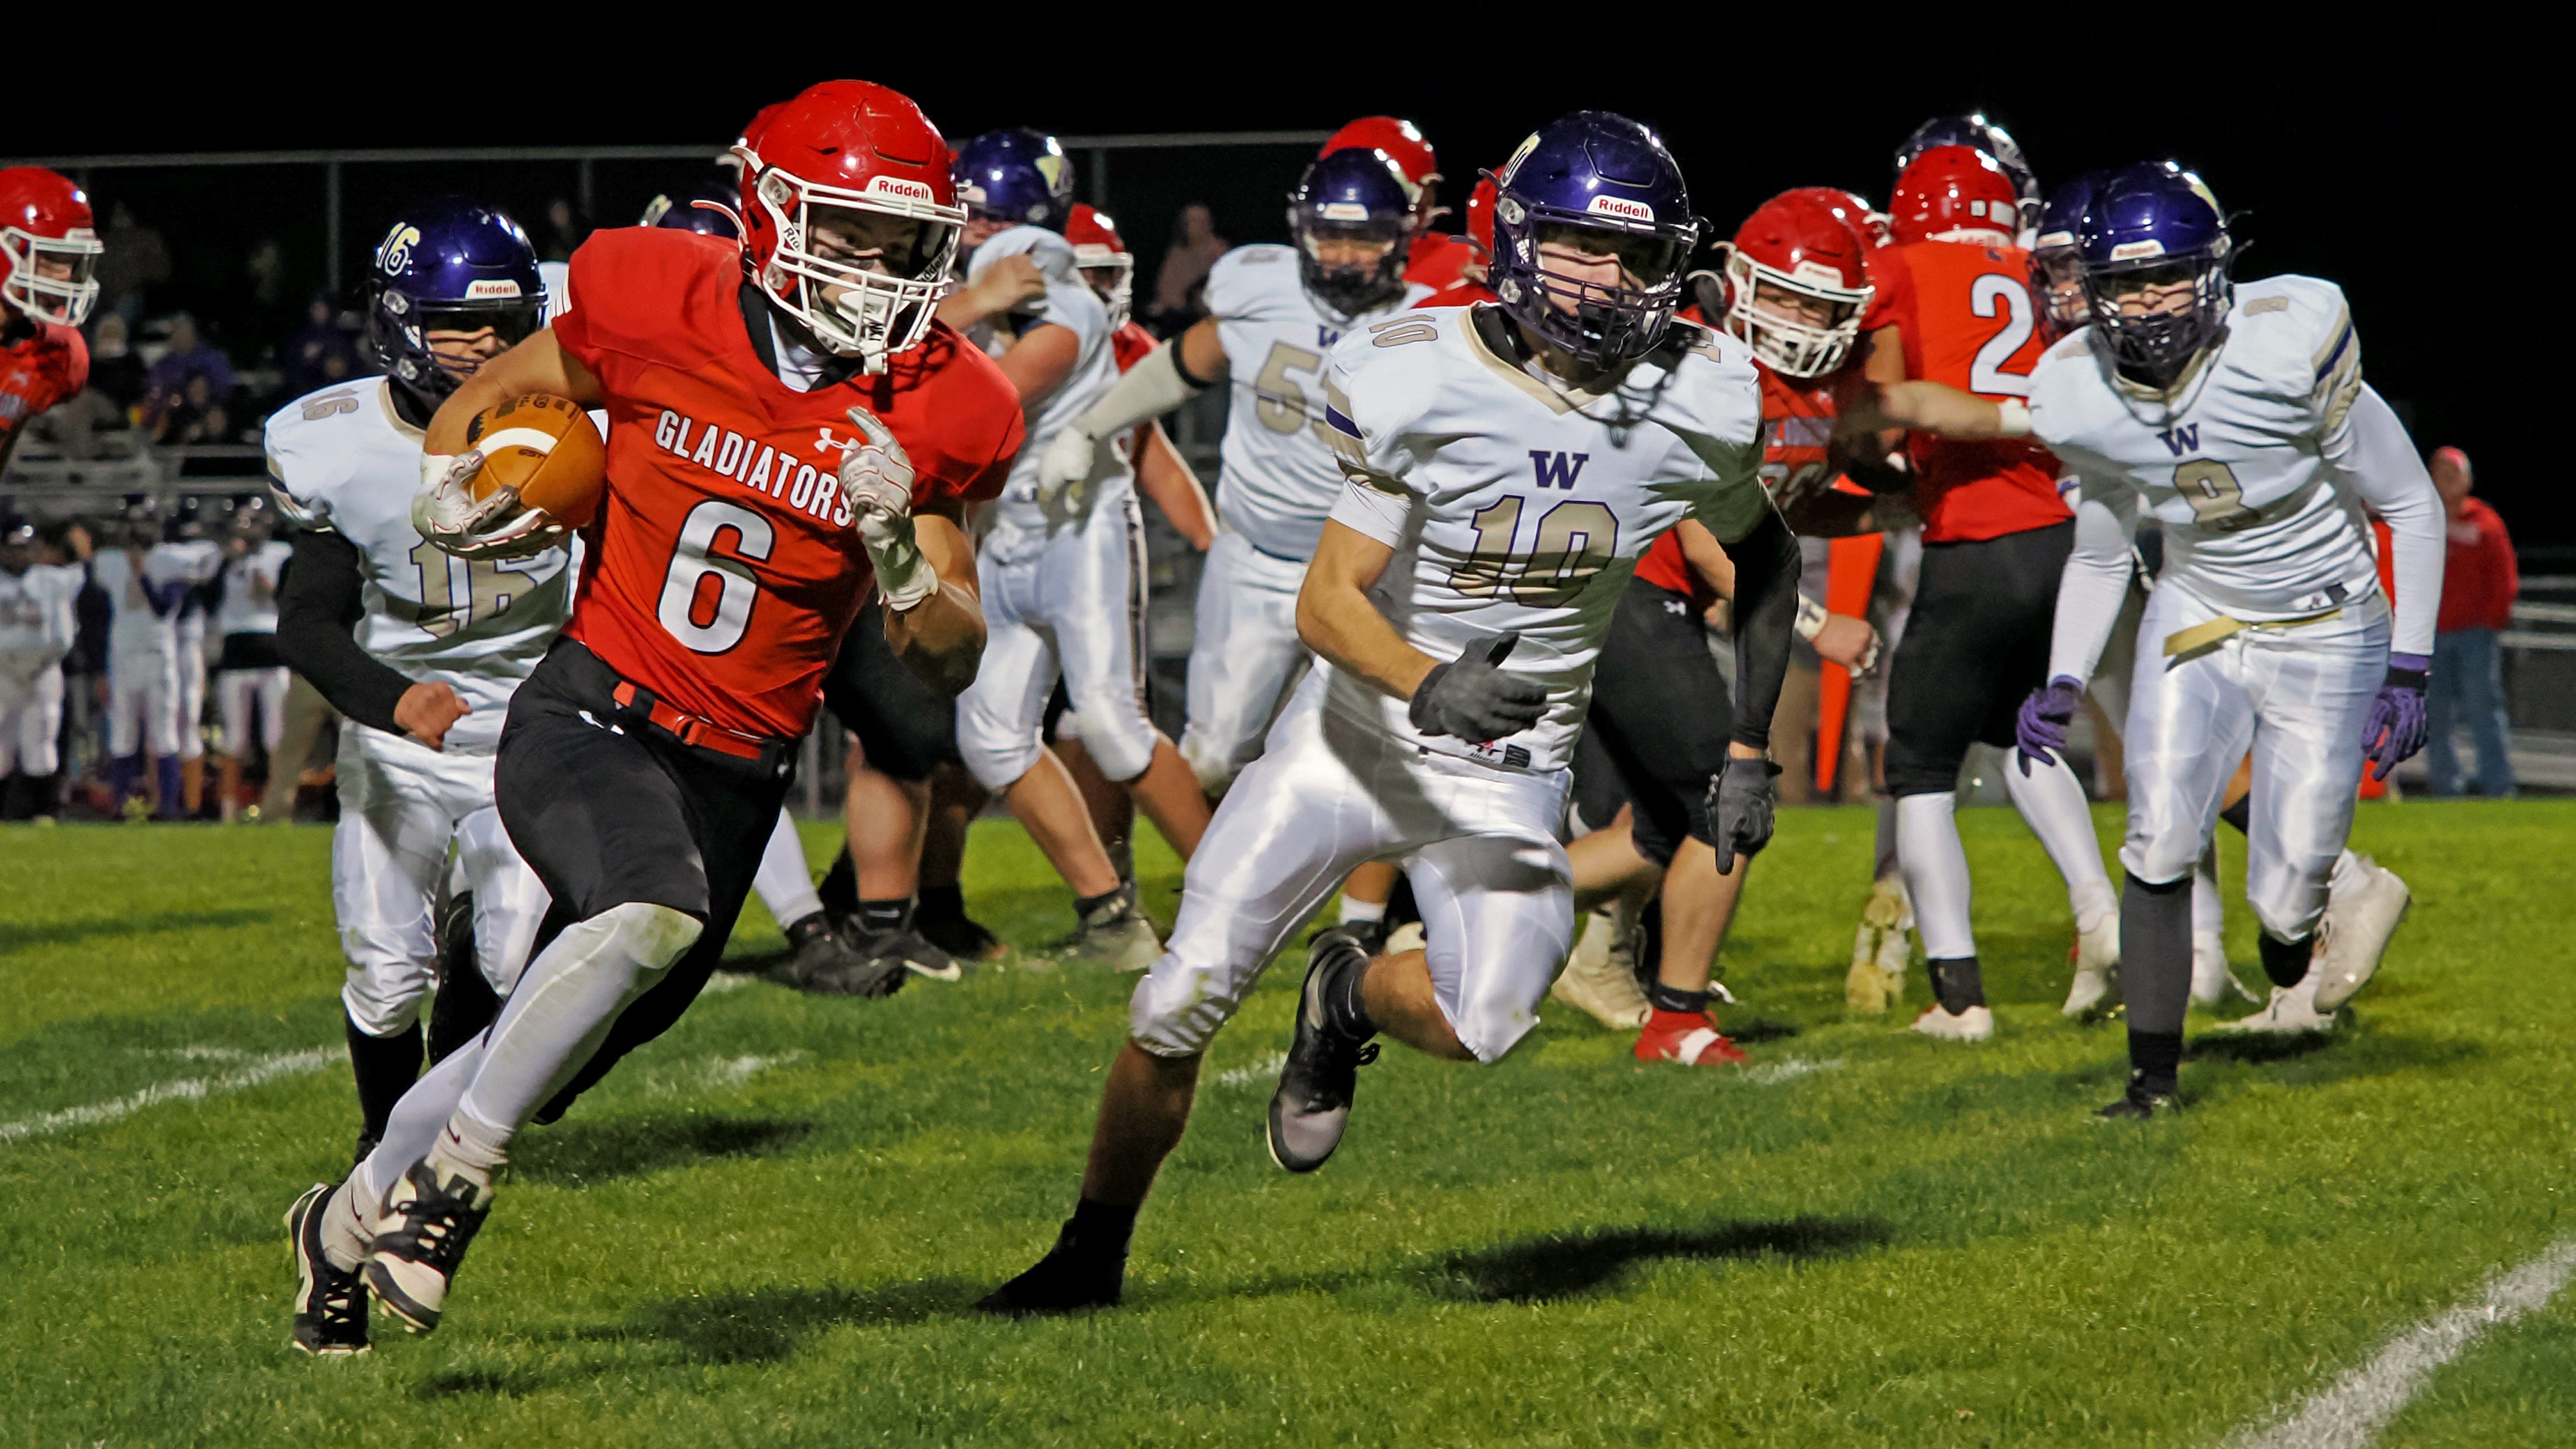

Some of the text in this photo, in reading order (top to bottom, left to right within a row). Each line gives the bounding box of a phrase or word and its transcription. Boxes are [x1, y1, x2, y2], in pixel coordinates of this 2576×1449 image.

[878, 180, 929, 200] Riddell
[1599, 198, 1649, 219] Riddell
[375, 221, 420, 276] 16
[476, 285, 516, 294] Riddell
[1369, 314, 1439, 348] 10
[1970, 272, 2035, 398] 2
[301, 388, 359, 421] 16
[2156, 422, 2200, 457] W
[654, 409, 854, 528] GLADIATORS
[1528, 450, 1589, 490] W
[1447, 494, 1619, 609] 10
[656, 496, 777, 657] 6
